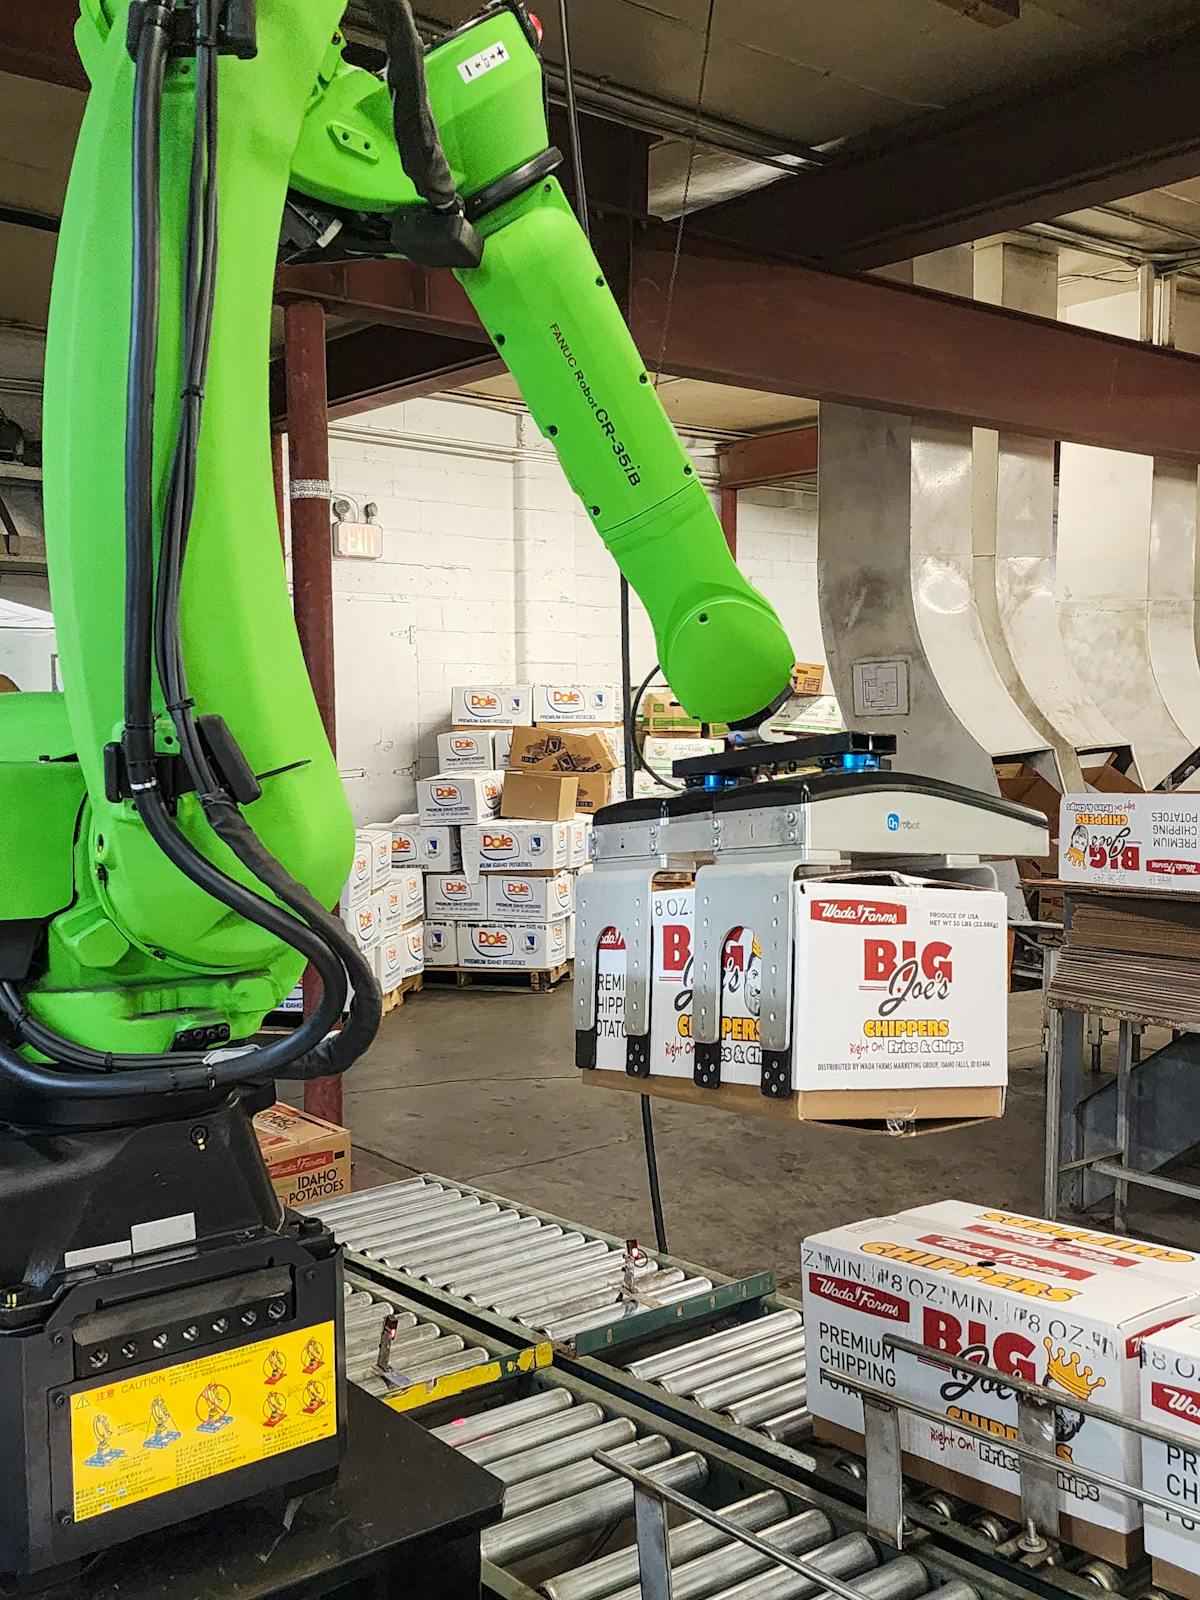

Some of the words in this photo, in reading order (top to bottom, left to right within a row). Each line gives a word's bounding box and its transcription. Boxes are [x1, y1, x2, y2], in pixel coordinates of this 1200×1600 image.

[549, 322, 577, 368] FANUC
[574, 369, 598, 409] Robot
[595, 408, 641, 486] CR-35iB
[471, 695, 497, 708] Dole
[553, 691, 580, 703] Dole
[454, 740, 474, 749] Dole
[436, 787, 458, 797] Dole
[1075, 813, 1128, 826] CHIPPERS
[1152, 812, 1198, 823] POTATOES
[1152, 825, 1198, 836] CHIPPING
[392, 837, 411, 849] ole
[483, 834, 513, 848] Dole
[1090, 827, 1131, 858] Joe's
[1153, 838, 1197, 848] PREMIUM
[1089, 845, 1140, 871] BIG
[446, 882, 467, 892] Dole
[508, 884, 529, 893] Dole
[655, 900, 662, 917] 8
[666, 898, 693, 916] OZ.
[860, 906, 898, 924] Farms
[479, 932, 508, 944] Dole
[864, 938, 952, 983] BIG
[878, 960, 950, 1017] Joe's
[863, 1019, 950, 1038] CHIPPERS
[849, 1038, 869, 1060] Right
[888, 1040, 918, 1054] Fries
[920, 1040, 931, 1053] &
[932, 1039, 964, 1055] Chips
[818, 1063, 851, 1071] DISTRIBUTED
[860, 1062, 874, 1070] WADA
[876, 1062, 892, 1070] FARMS
[894, 1062, 922, 1070] MARKETING
[298, 1169, 337, 1190] IDAHO
[289, 1180, 344, 1204] POTATOES
[976, 1212, 1196, 1263] CHIPPERS
[860, 1241, 1084, 1302] CHIPPERS
[816, 1277, 856, 1302] Wada
[858, 1290, 900, 1317] Farms
[820, 1322, 896, 1364] PREMIUM
[923, 1306, 1036, 1385] BIG
[820, 1345, 896, 1388] CHIPPING
[121, 1374, 166, 1394] CAUTION
[96, 1388, 116, 1402] 注意
[930, 1425, 954, 1452] Right
[958, 1436, 976, 1452] On!
[1057, 1470, 1100, 1501] hips
